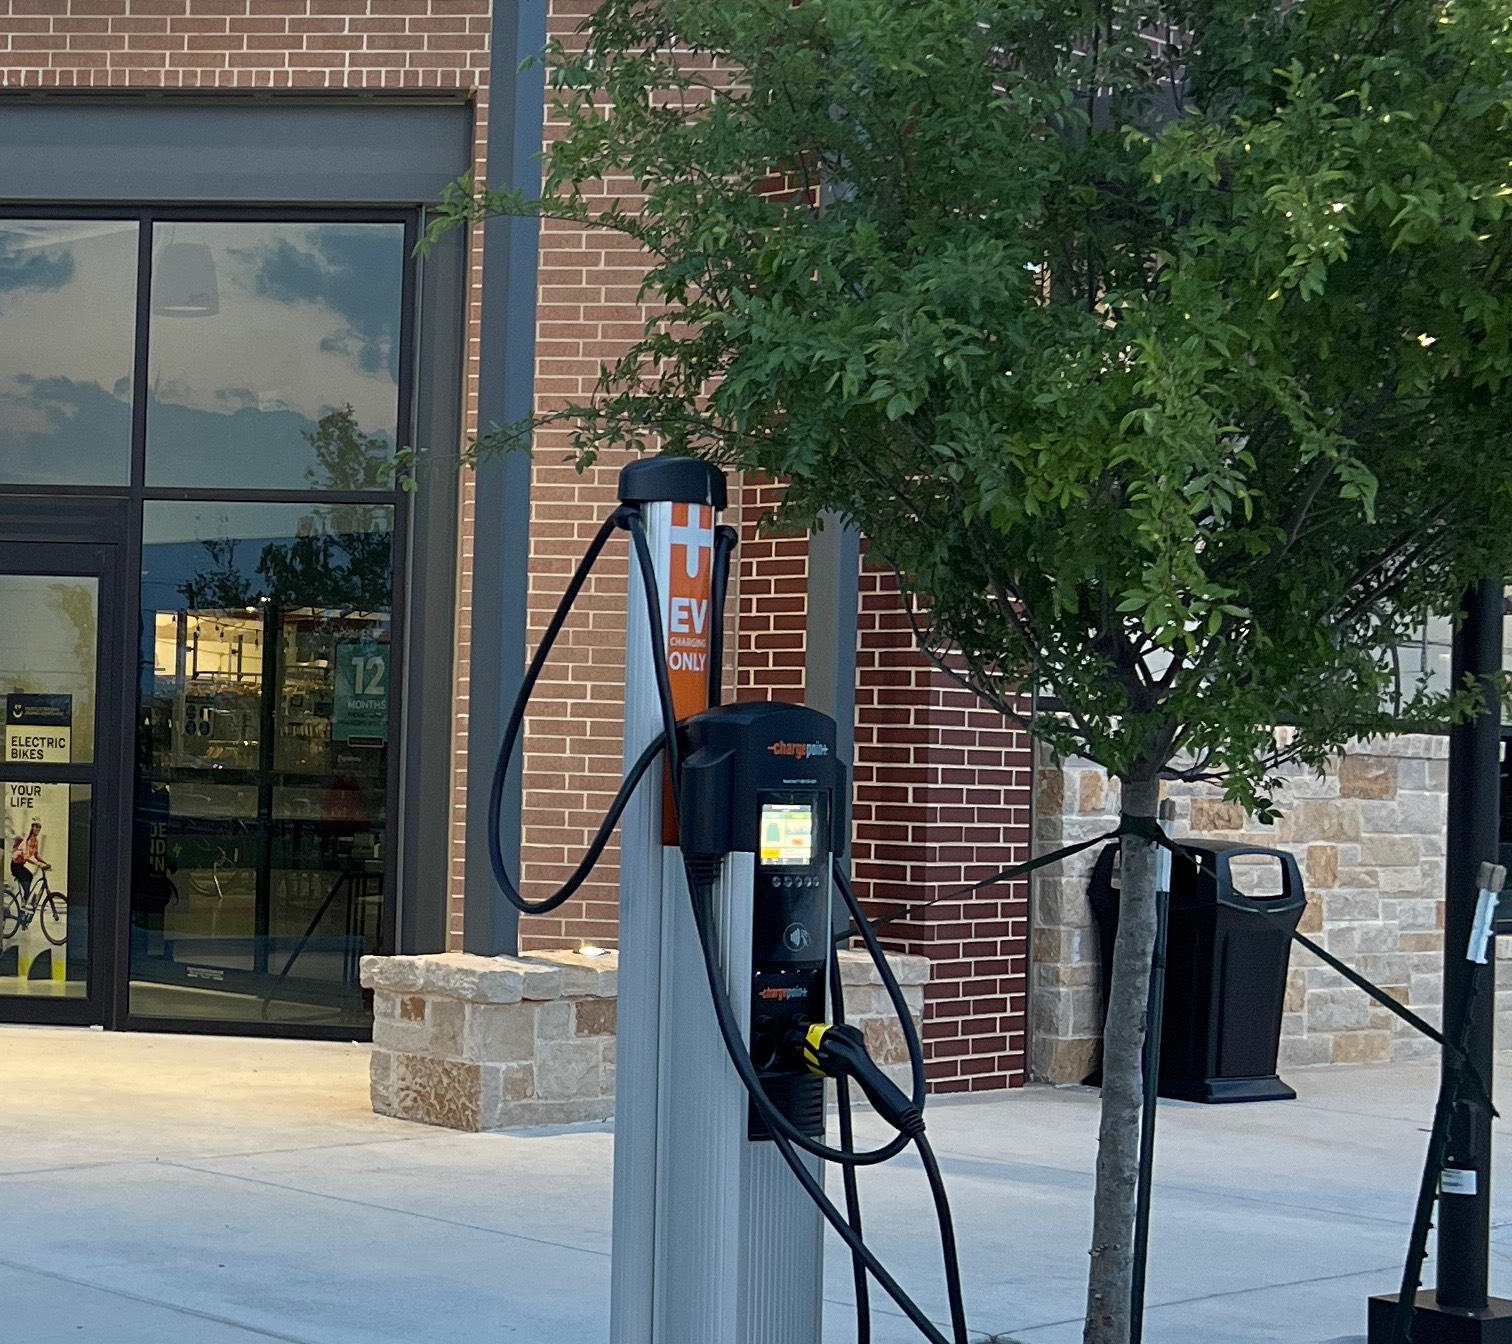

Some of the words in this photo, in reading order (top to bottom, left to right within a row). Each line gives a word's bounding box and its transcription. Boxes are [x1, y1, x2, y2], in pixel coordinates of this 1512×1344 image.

[670, 596, 708, 636] EV
[669, 636, 707, 649] CHARGING
[668, 650, 707, 672] ONLY
[351, 656, 385, 695] 12
[10, 735, 66, 749] ELECTRIC
[10, 747, 44, 760] BIKES
[10, 784, 42, 797] YOUR
[9, 796, 34, 809] LIFE
